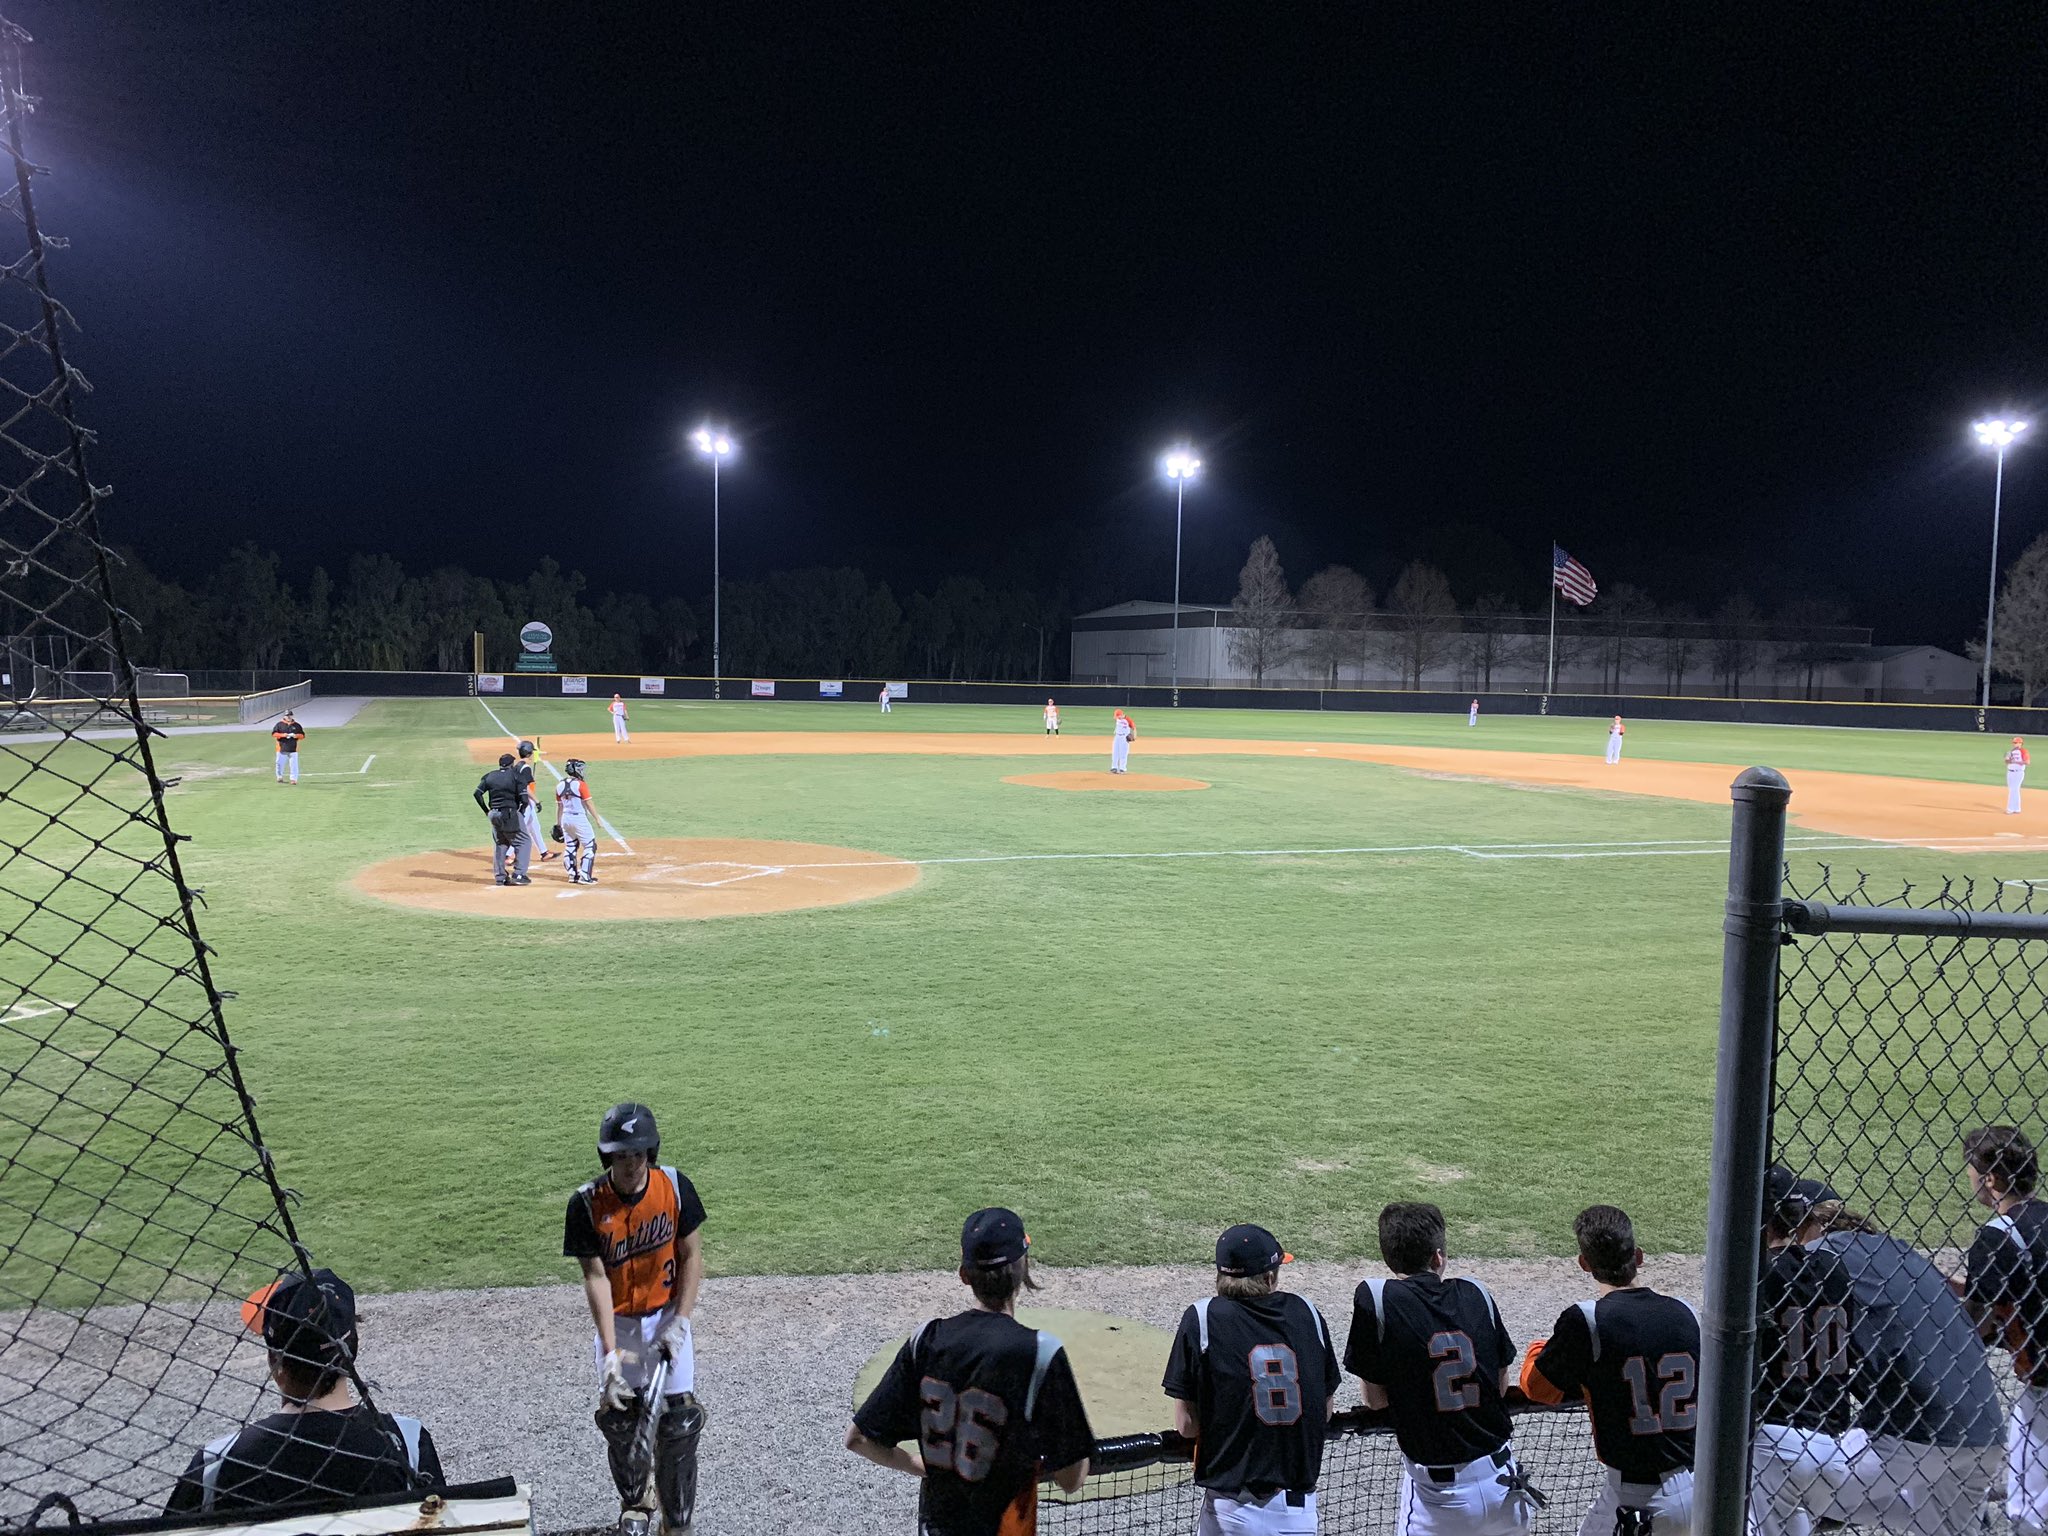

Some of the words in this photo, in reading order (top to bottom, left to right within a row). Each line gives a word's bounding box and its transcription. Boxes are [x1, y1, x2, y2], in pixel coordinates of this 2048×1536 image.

[1427, 1329, 1481, 1412] 2
[1778, 1304, 1849, 1379] 10
[1247, 1342, 1303, 1427] 8
[1622, 1351, 1697, 1435] 12
[920, 1375, 1009, 1481] 26
